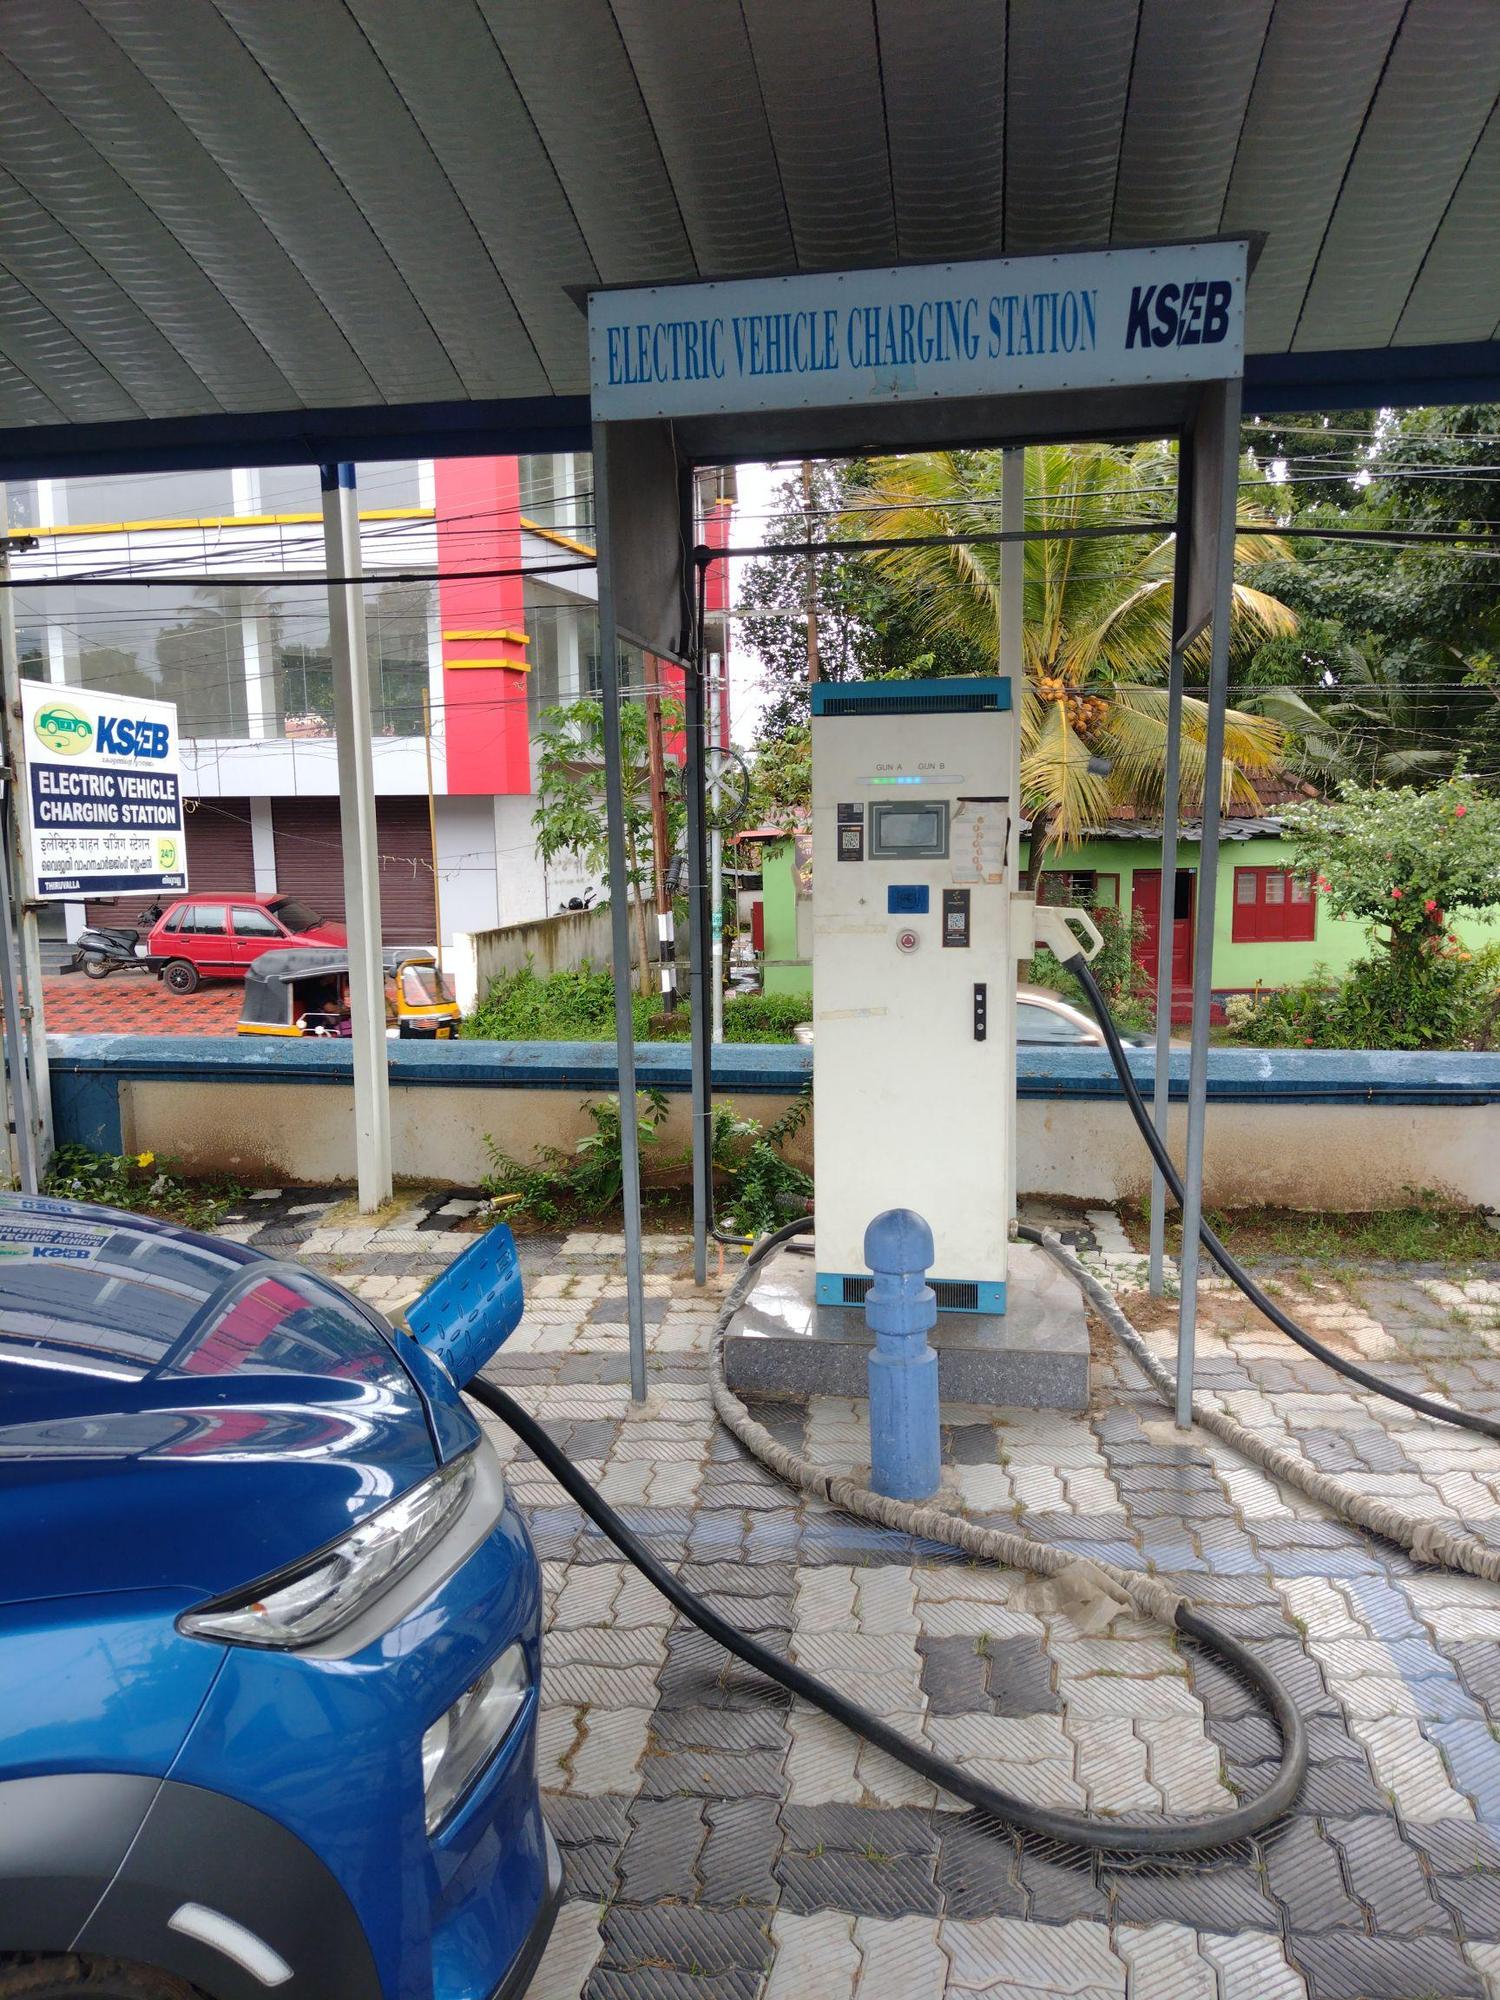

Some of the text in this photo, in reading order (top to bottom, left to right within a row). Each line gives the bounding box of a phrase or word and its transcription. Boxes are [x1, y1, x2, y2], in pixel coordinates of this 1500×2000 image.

[1125, 278, 1232, 350] KSEB
[607, 289, 1098, 386] ELECTRIC VEHICLE CHARGING STATION
[96, 715, 169, 759] KSEB
[876, 763, 903, 771] GUN A
[918, 762, 936, 770] GUN
[39, 772, 175, 800] ELECTRIC VEHICLE
[40, 801, 176, 824] CHARGING STATION
[79, 838, 99, 853] वाहन
[129, 833, 150, 851] स्टेशन
[45, 880, 80, 890] THIRUVALLA
